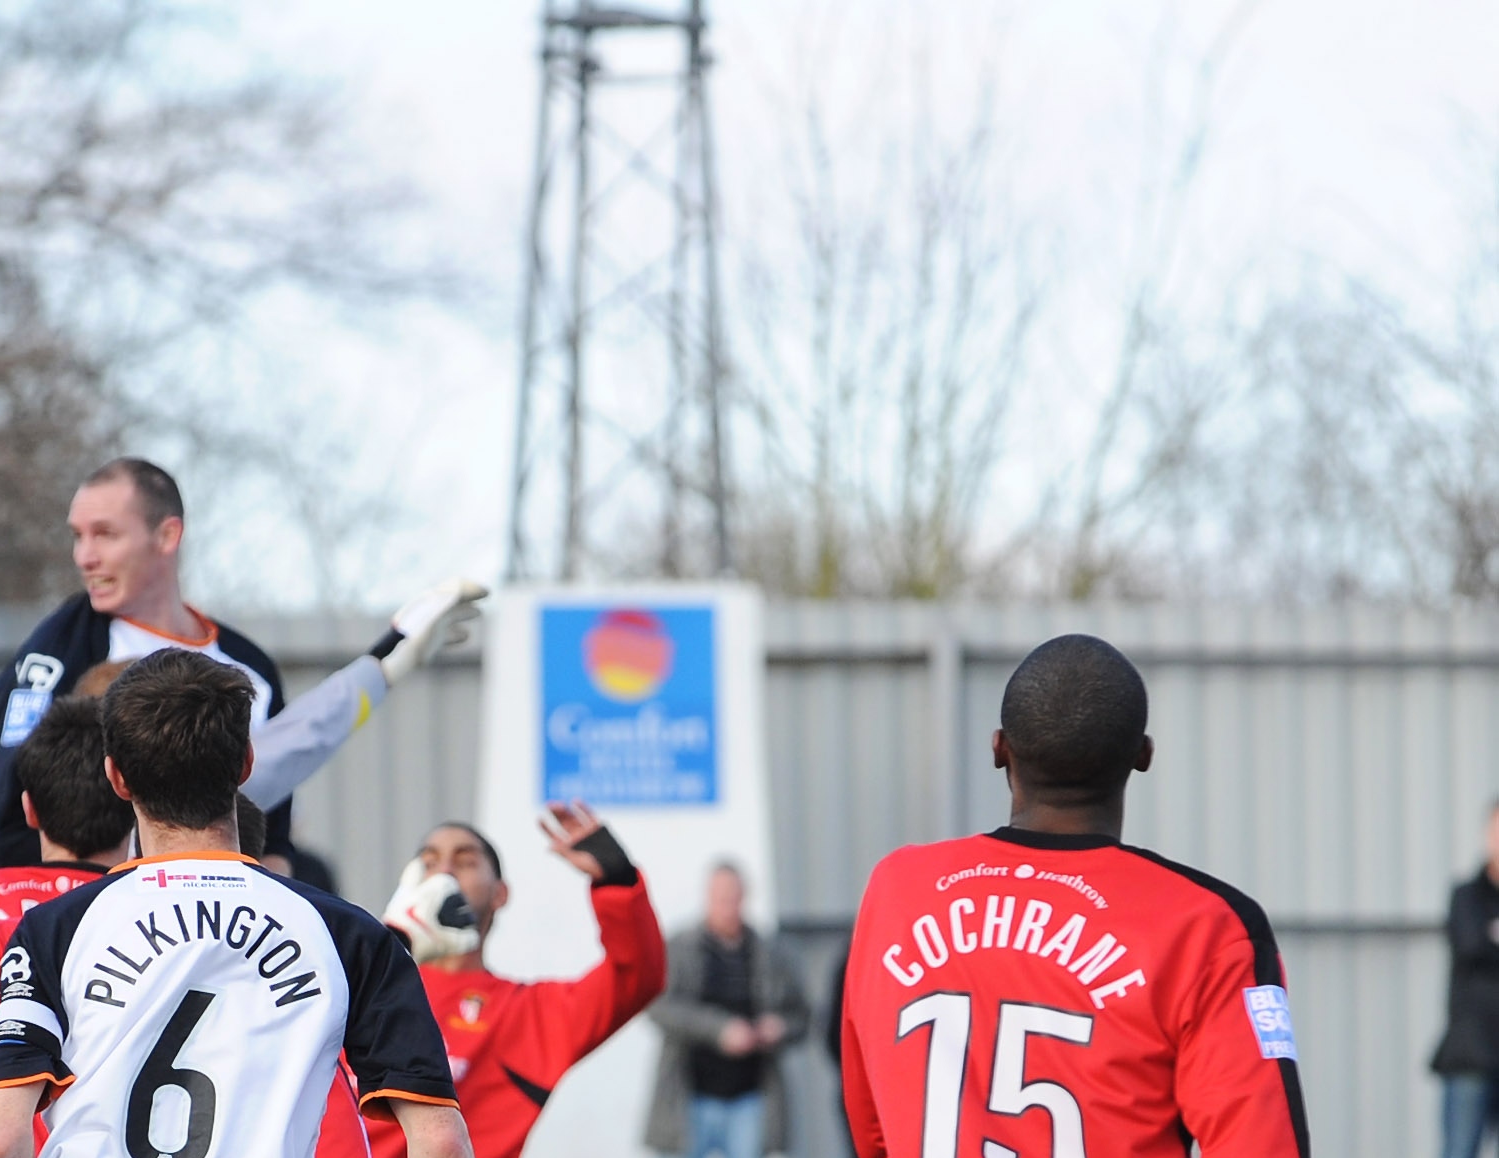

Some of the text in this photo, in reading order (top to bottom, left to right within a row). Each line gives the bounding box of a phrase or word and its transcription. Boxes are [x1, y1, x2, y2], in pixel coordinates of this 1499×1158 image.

[935, 863, 1109, 910] Comfort Heathrow
[84, 900, 322, 1008] PILKINGTON
[882, 895, 1147, 1010] COCHRANE
